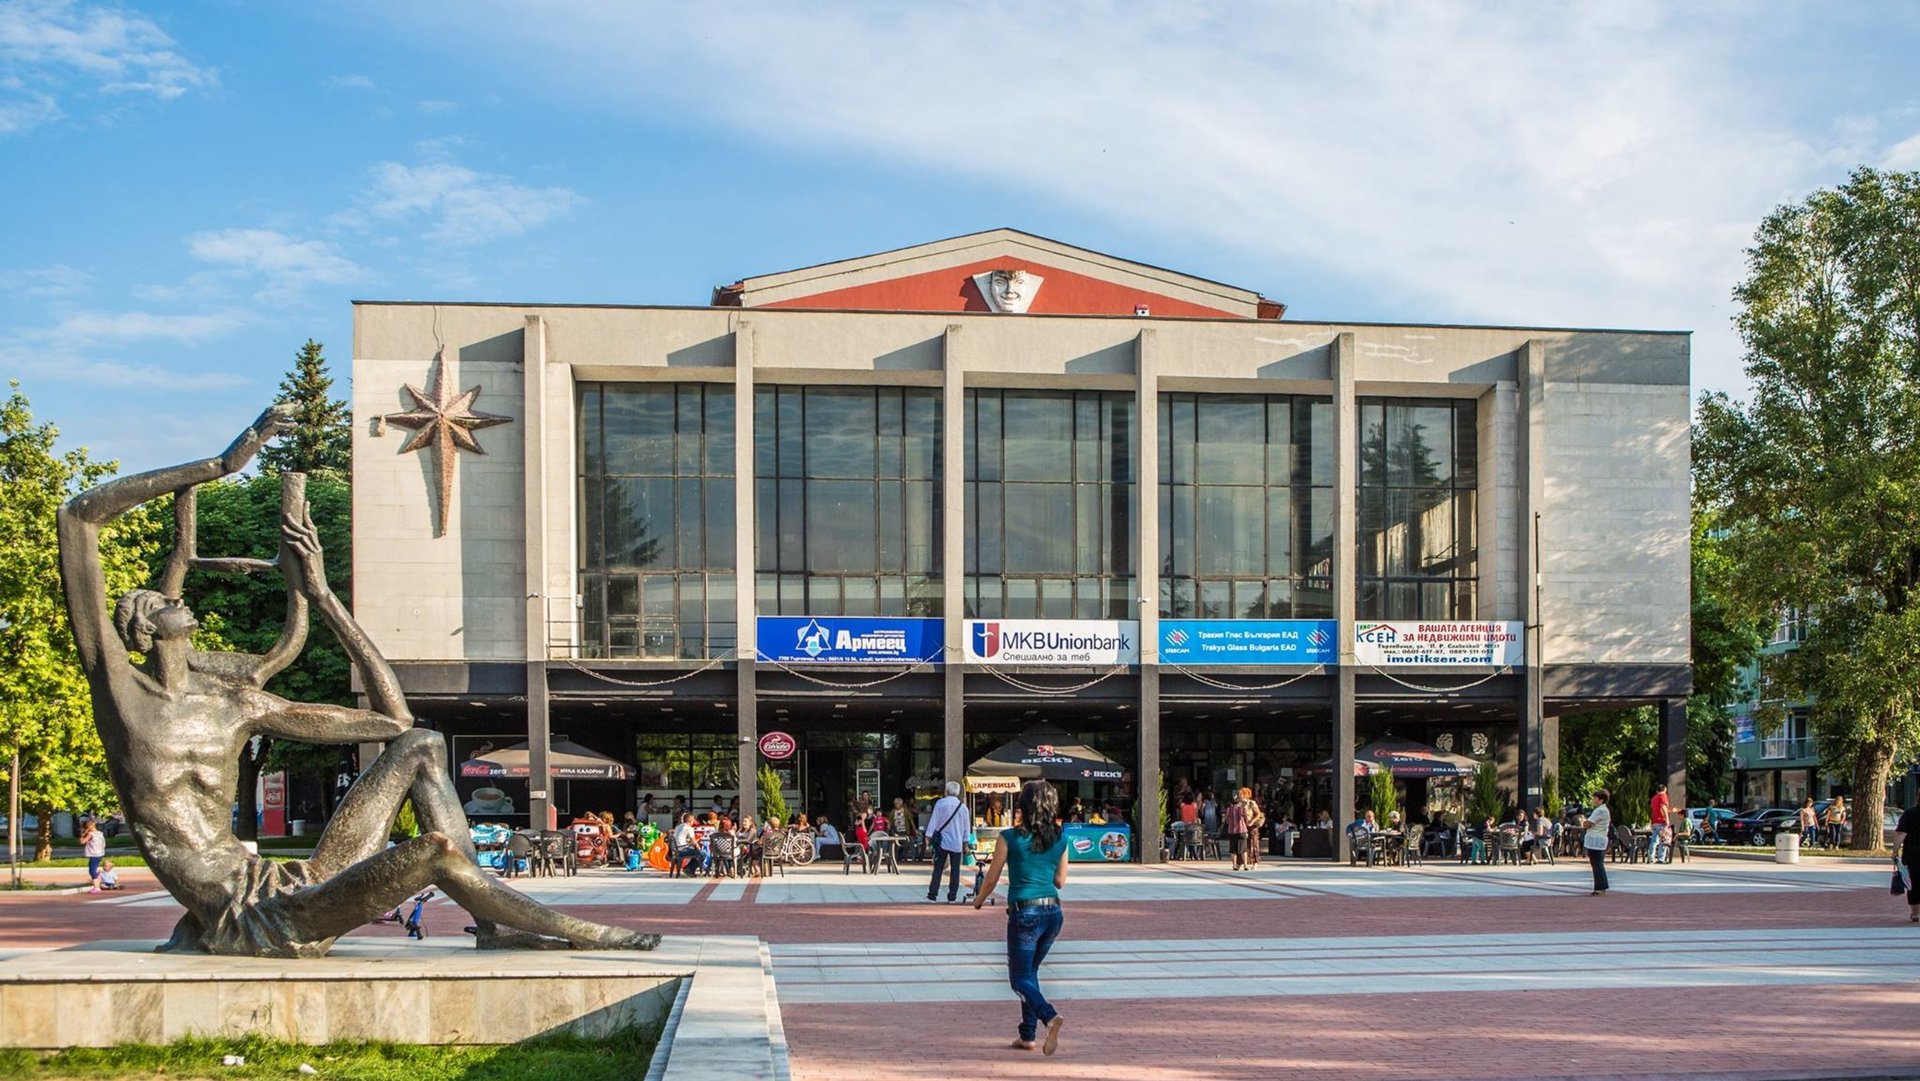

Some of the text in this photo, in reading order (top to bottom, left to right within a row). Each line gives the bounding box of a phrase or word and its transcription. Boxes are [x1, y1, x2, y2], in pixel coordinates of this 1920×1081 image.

[1418, 624, 1501, 634] ВАШАТА АГЕНЦИЯ
[1198, 631, 1299, 640] Тракия Глас България ЕАД
[1402, 633, 1517, 643] ЗА НЕДВИЖИМИ ИМОТИ
[835, 630, 906, 652] Армеец
[1201, 644, 1226, 653] Trakya
[1249, 644, 1280, 653] Bulgaria
[1003, 651, 1054, 662] Специално
[1071, 652, 1091, 661] теб
[1387, 654, 1492, 664] imotiksen.com
[1093, 770, 1122, 778] BECK'S
[971, 781, 1016, 790] ЦАРЕВИЦА
